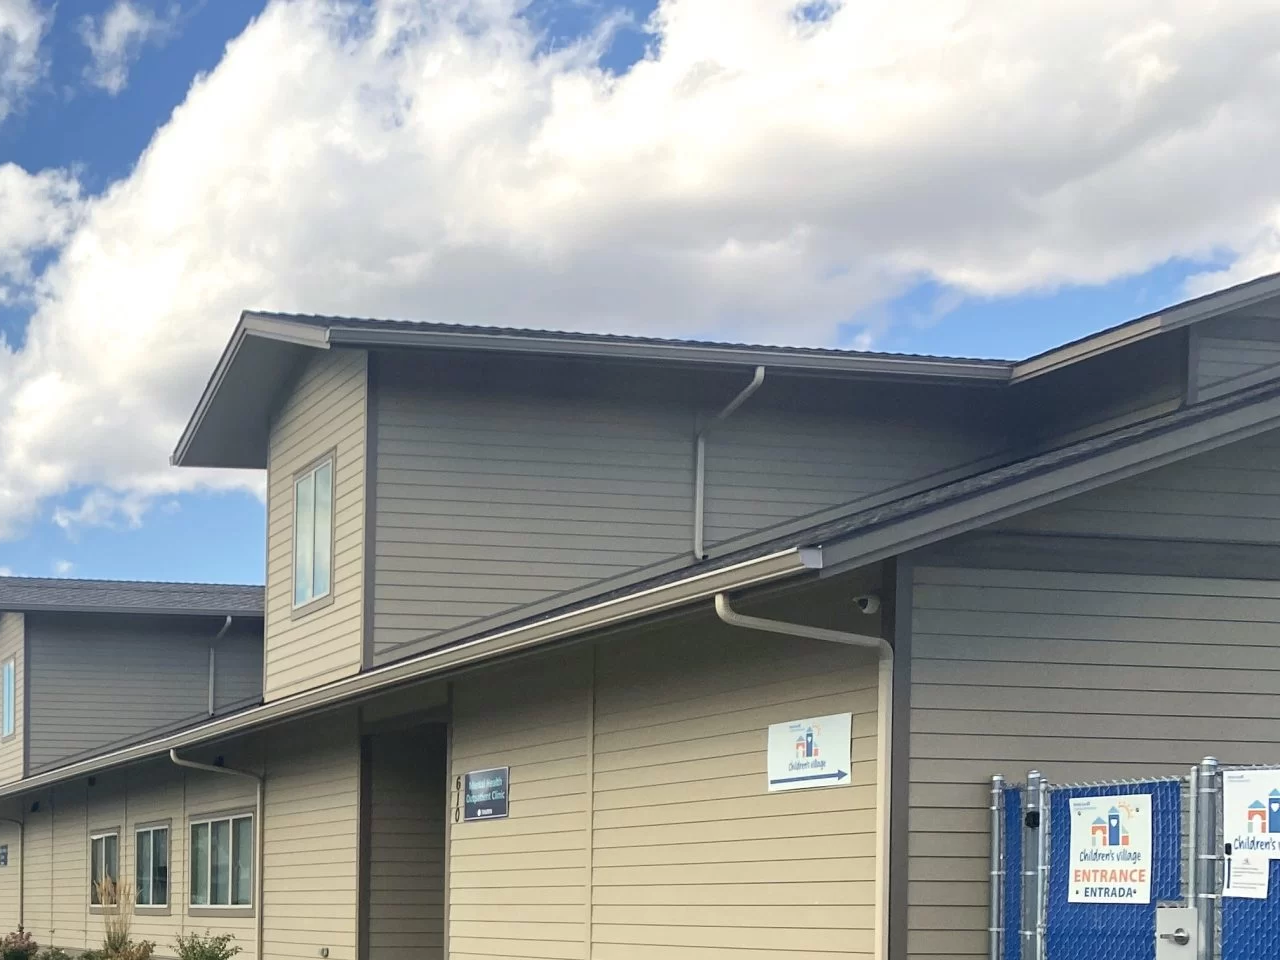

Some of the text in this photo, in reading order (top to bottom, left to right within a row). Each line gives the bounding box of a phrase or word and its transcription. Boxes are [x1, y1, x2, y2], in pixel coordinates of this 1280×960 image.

[466, 790, 505, 804] Outpatient Clinic
[1234, 835, 1276, 850] Children's
[1080, 849, 1142, 865] Children's village
[1074, 869, 1146, 882] ENTRANCE
[1084, 887, 1133, 897] ENTRADA
